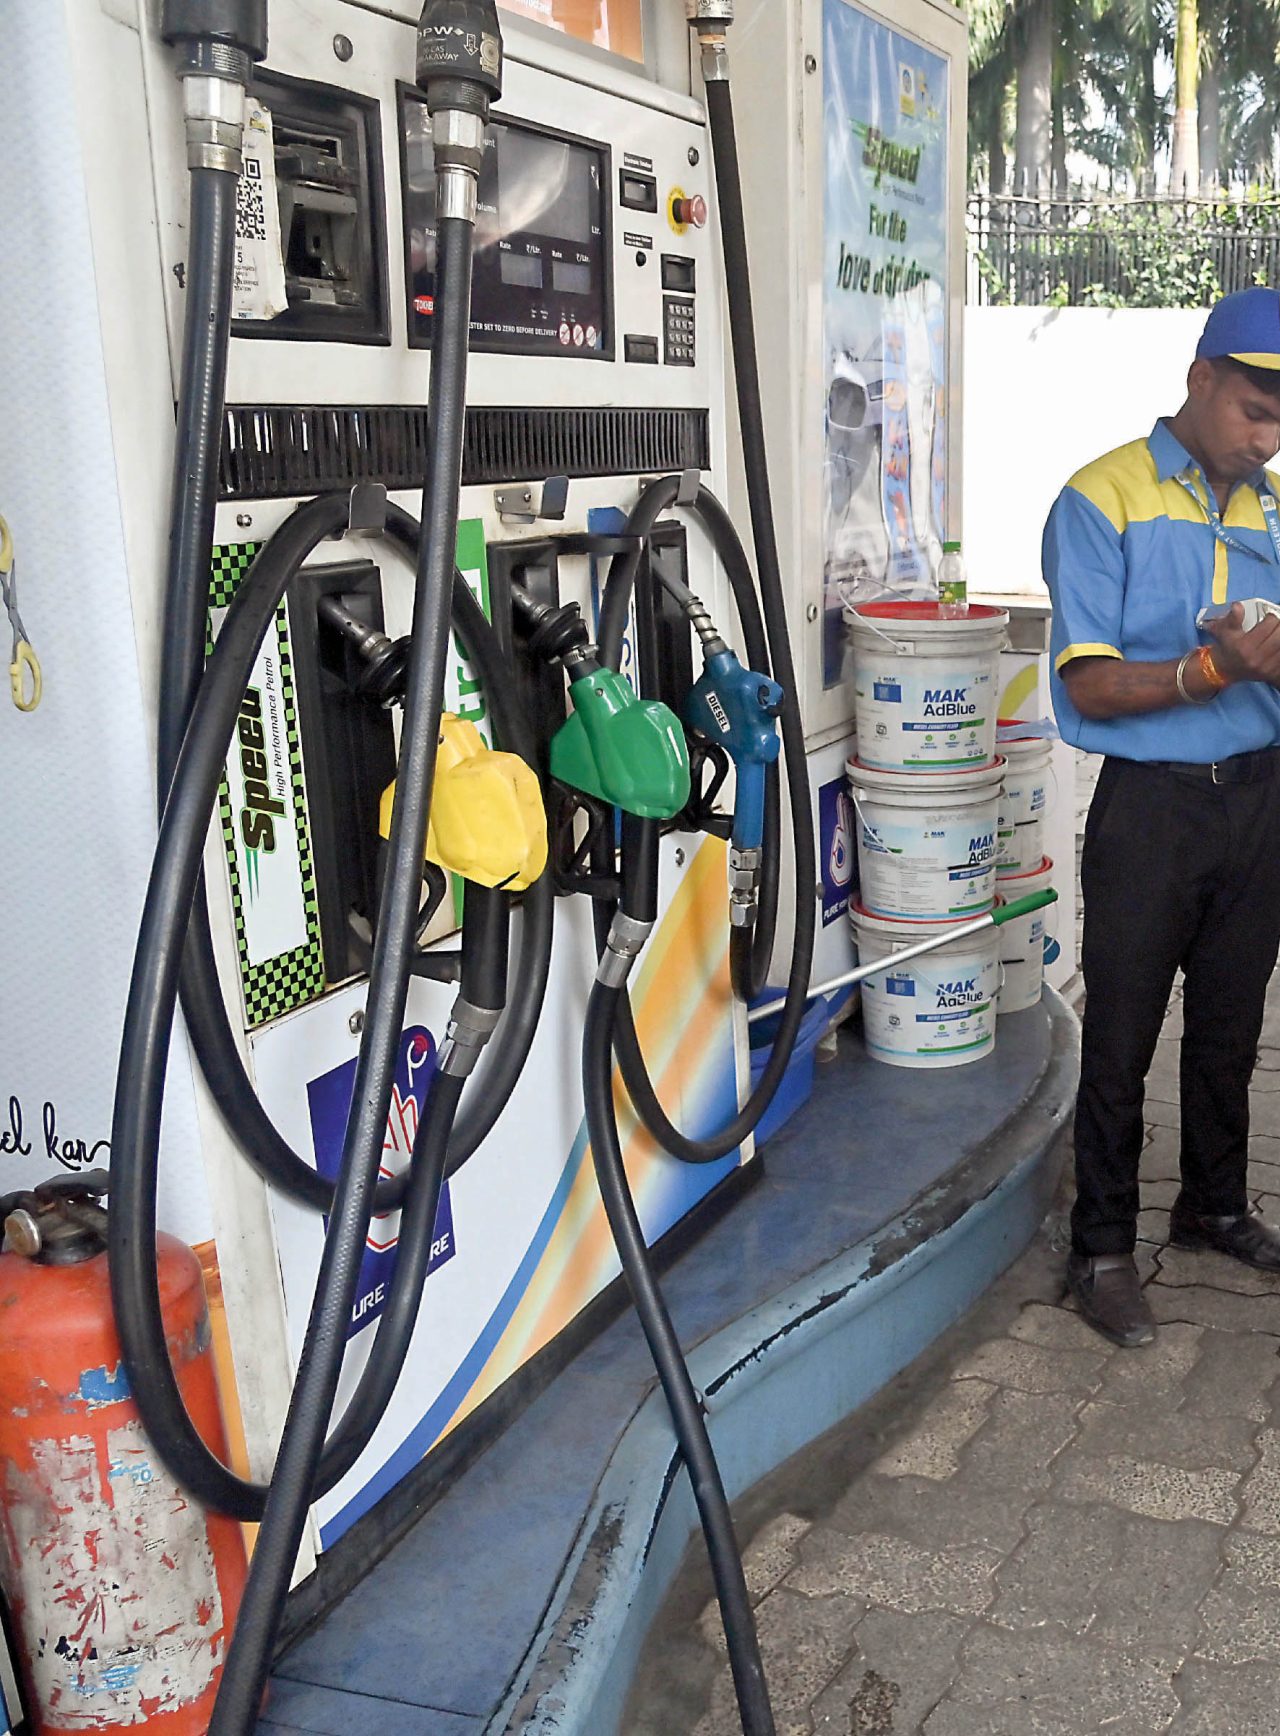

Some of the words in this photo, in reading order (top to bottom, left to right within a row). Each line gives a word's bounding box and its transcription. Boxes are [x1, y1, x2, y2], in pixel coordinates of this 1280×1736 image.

[837, 243, 871, 293] love
[502, 325, 515, 333] ZERO
[263, 656, 276, 692] Petrol
[923, 688, 967, 703] MAK
[923, 703, 976, 717] AdBlue
[708, 695, 728, 730] DIESEL
[268, 694, 283, 768] Performance
[277, 768, 287, 797] High
[935, 978, 976, 996] MAK
[352, 1283, 386, 1322] URE
[429, 1232, 450, 1262] RE
